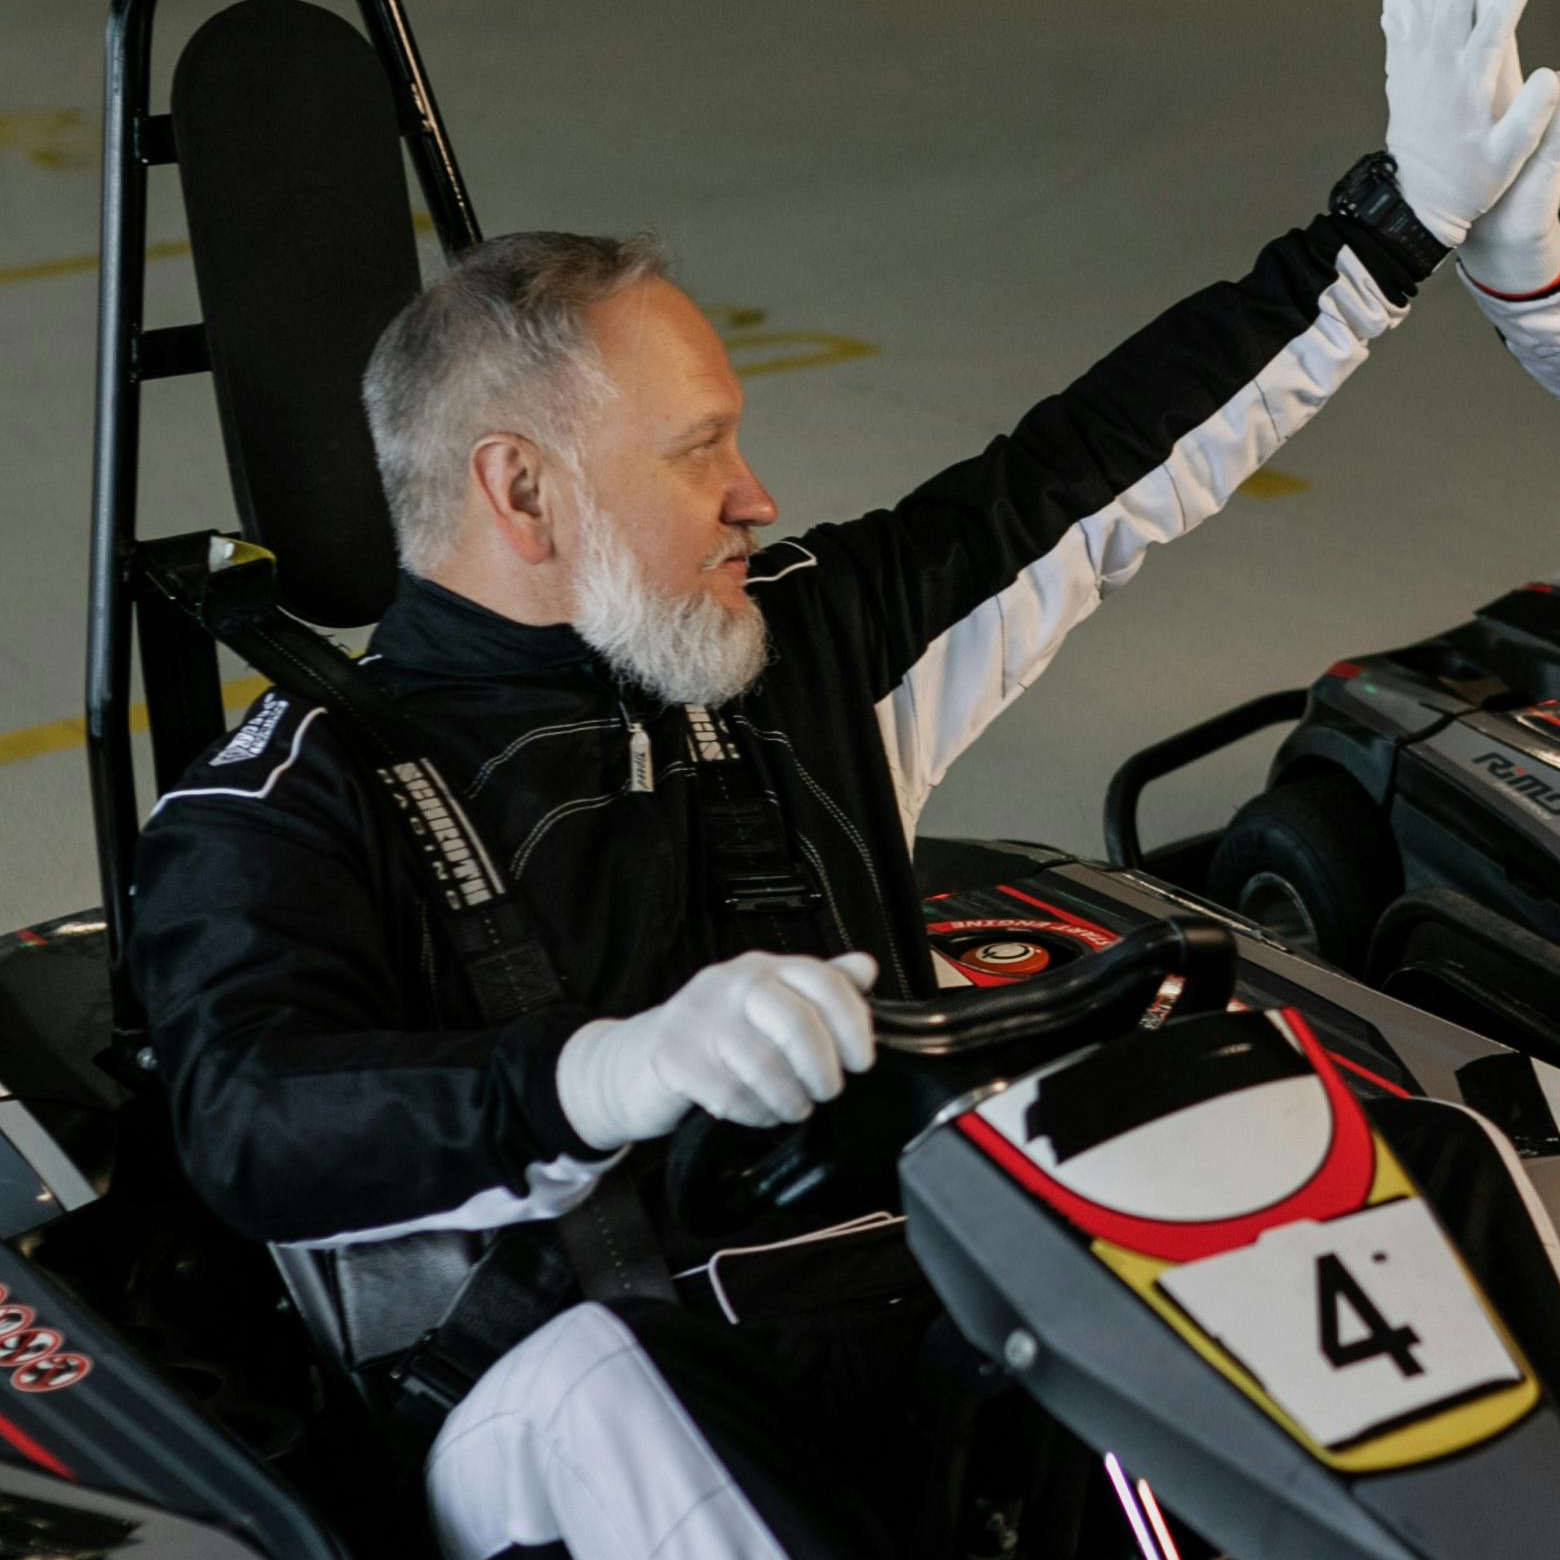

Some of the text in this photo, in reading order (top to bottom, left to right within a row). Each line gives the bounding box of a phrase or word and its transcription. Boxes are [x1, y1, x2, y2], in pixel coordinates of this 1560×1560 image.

[376, 768, 462, 910] RACING
[392, 762, 493, 906] SCHROTH
[951, 919, 1051, 930] ENGINE
[1317, 1253, 1424, 1378] 4
